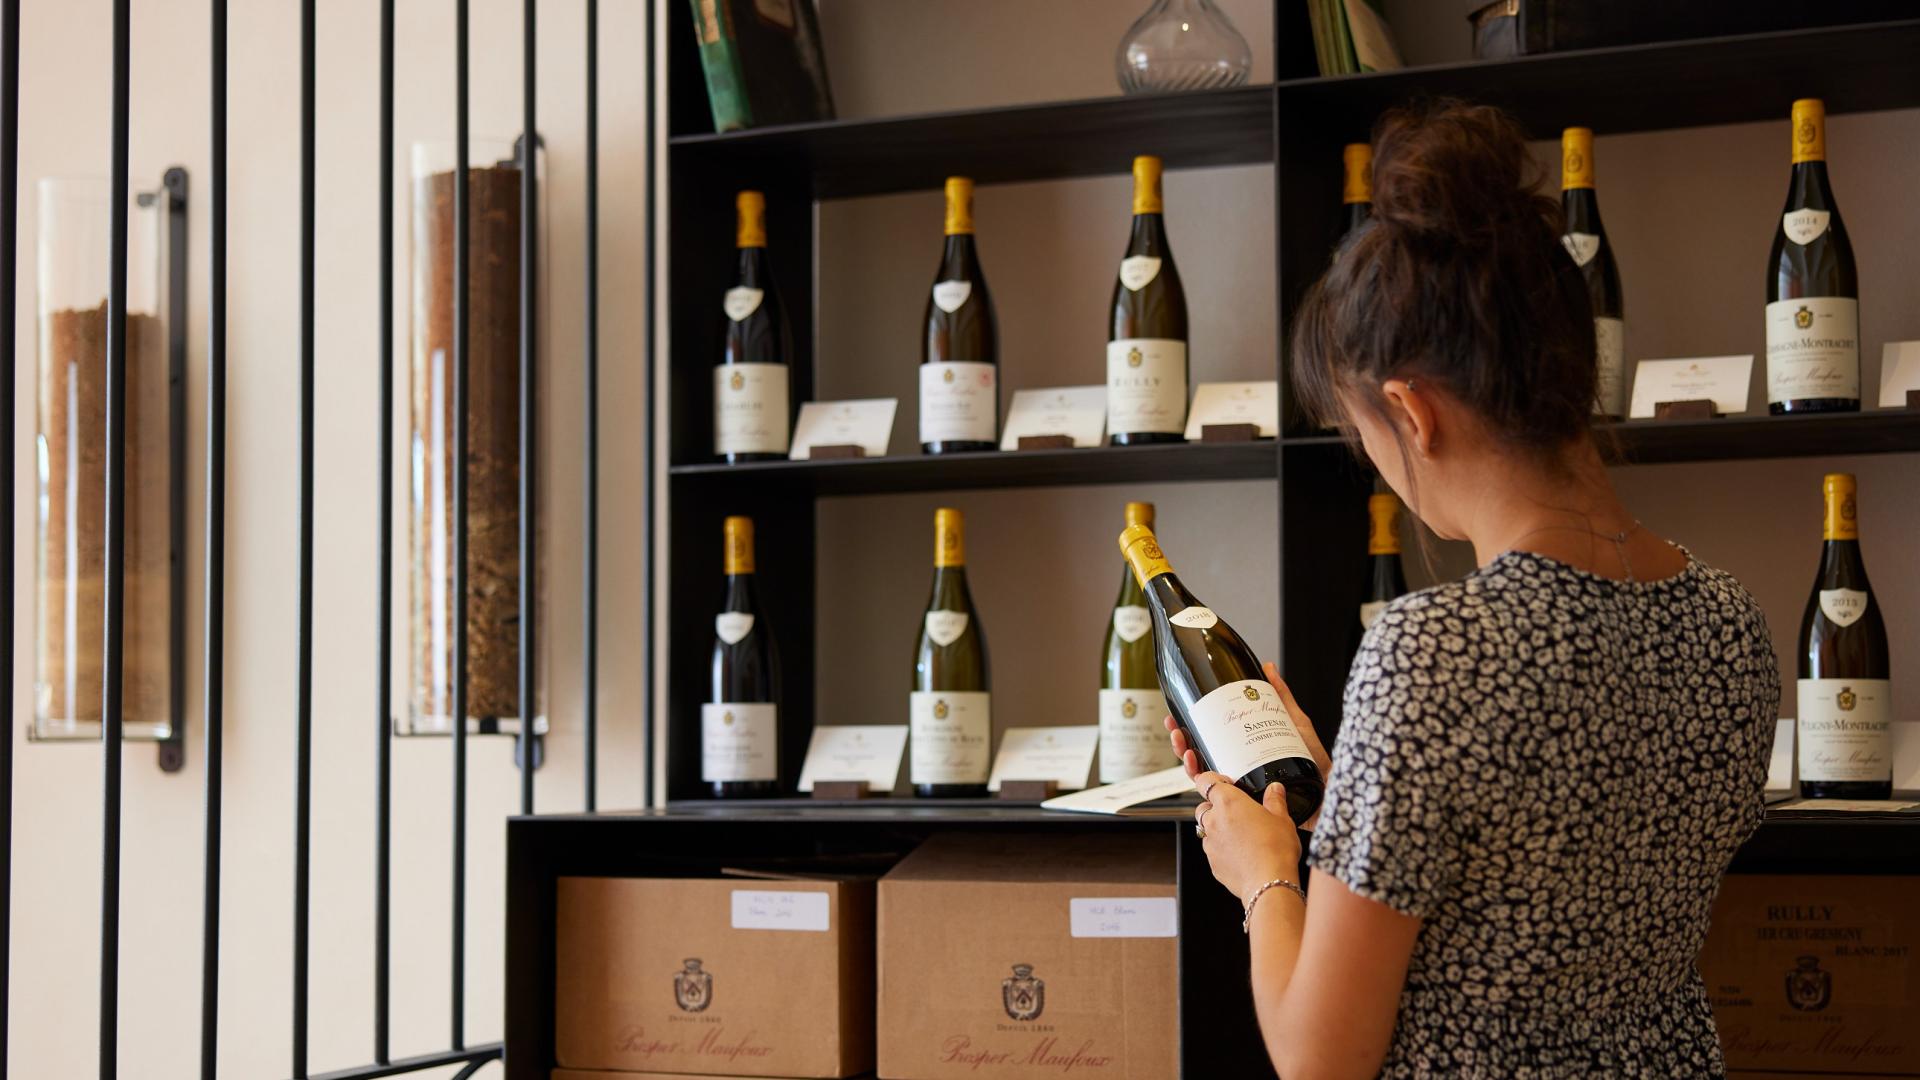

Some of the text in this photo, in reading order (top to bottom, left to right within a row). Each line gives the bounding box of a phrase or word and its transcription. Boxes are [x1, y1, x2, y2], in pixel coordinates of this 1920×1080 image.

[1243, 719, 1288, 733] SANTENAY
[1767, 905, 1835, 921] RULLY
[1779, 928, 1803, 941] CRU
[1835, 946, 1879, 957] BLANC
[614, 1024, 775, 1061] Prosper Maufoux
[941, 1034, 1113, 1072] Prosper Maufoux
